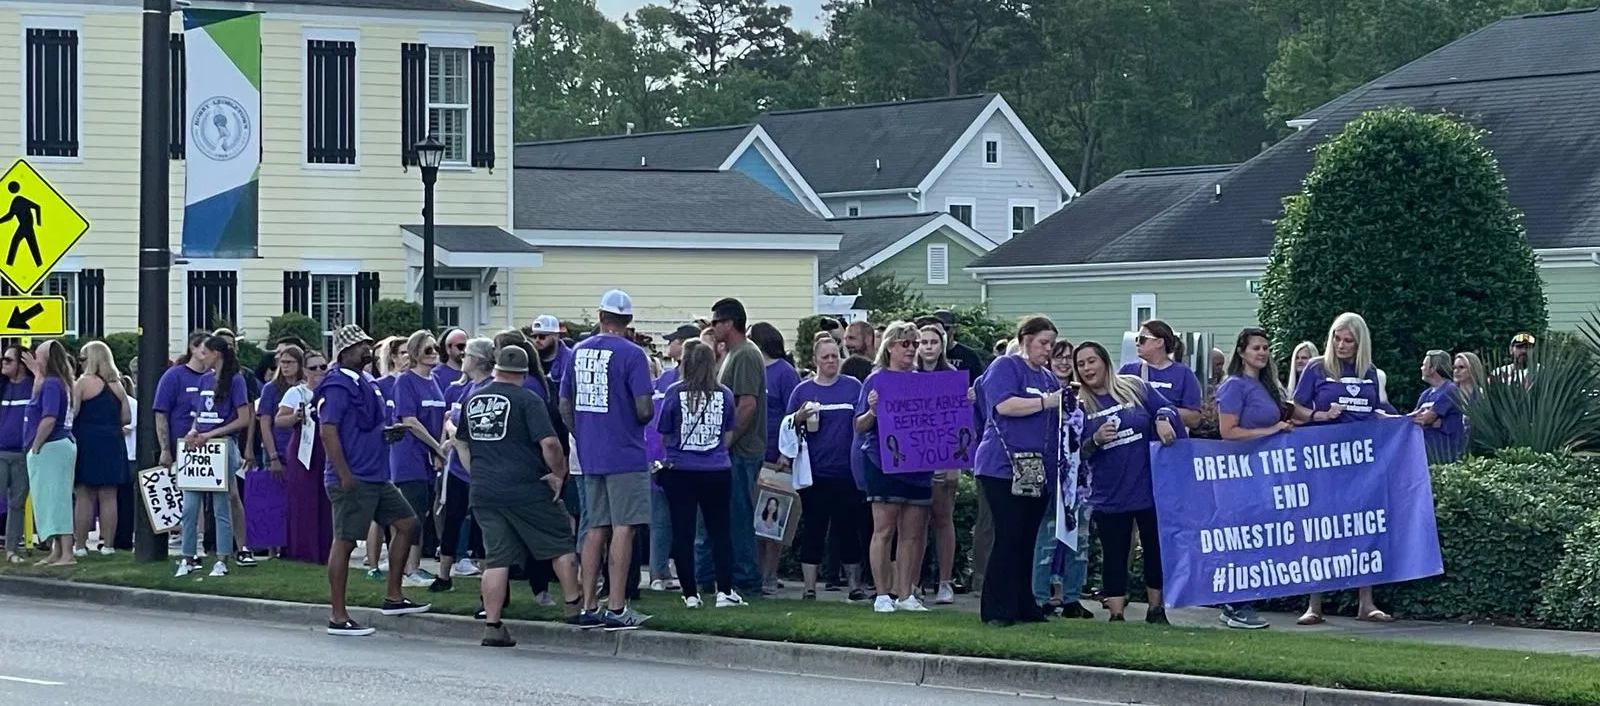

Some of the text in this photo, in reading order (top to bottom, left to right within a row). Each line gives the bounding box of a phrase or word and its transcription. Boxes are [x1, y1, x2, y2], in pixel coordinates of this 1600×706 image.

[575, 358, 608, 372] SILENCE
[935, 394, 969, 411] ABUSE
[704, 412, 723, 425] END
[939, 410, 958, 426] IT
[909, 427, 958, 448] STOPS
[191, 455, 212, 466] FOR
[916, 446, 949, 465] YOU
[1193, 438, 1375, 482] BREAK THE SILENCE
[147, 484, 162, 514] MICA
[162, 486, 177, 510] FOR
[1272, 482, 1310, 510] END
[1200, 509, 1387, 554] DOMESTIC VIOLENCE
[1212, 548, 1383, 593] #justiceformica
